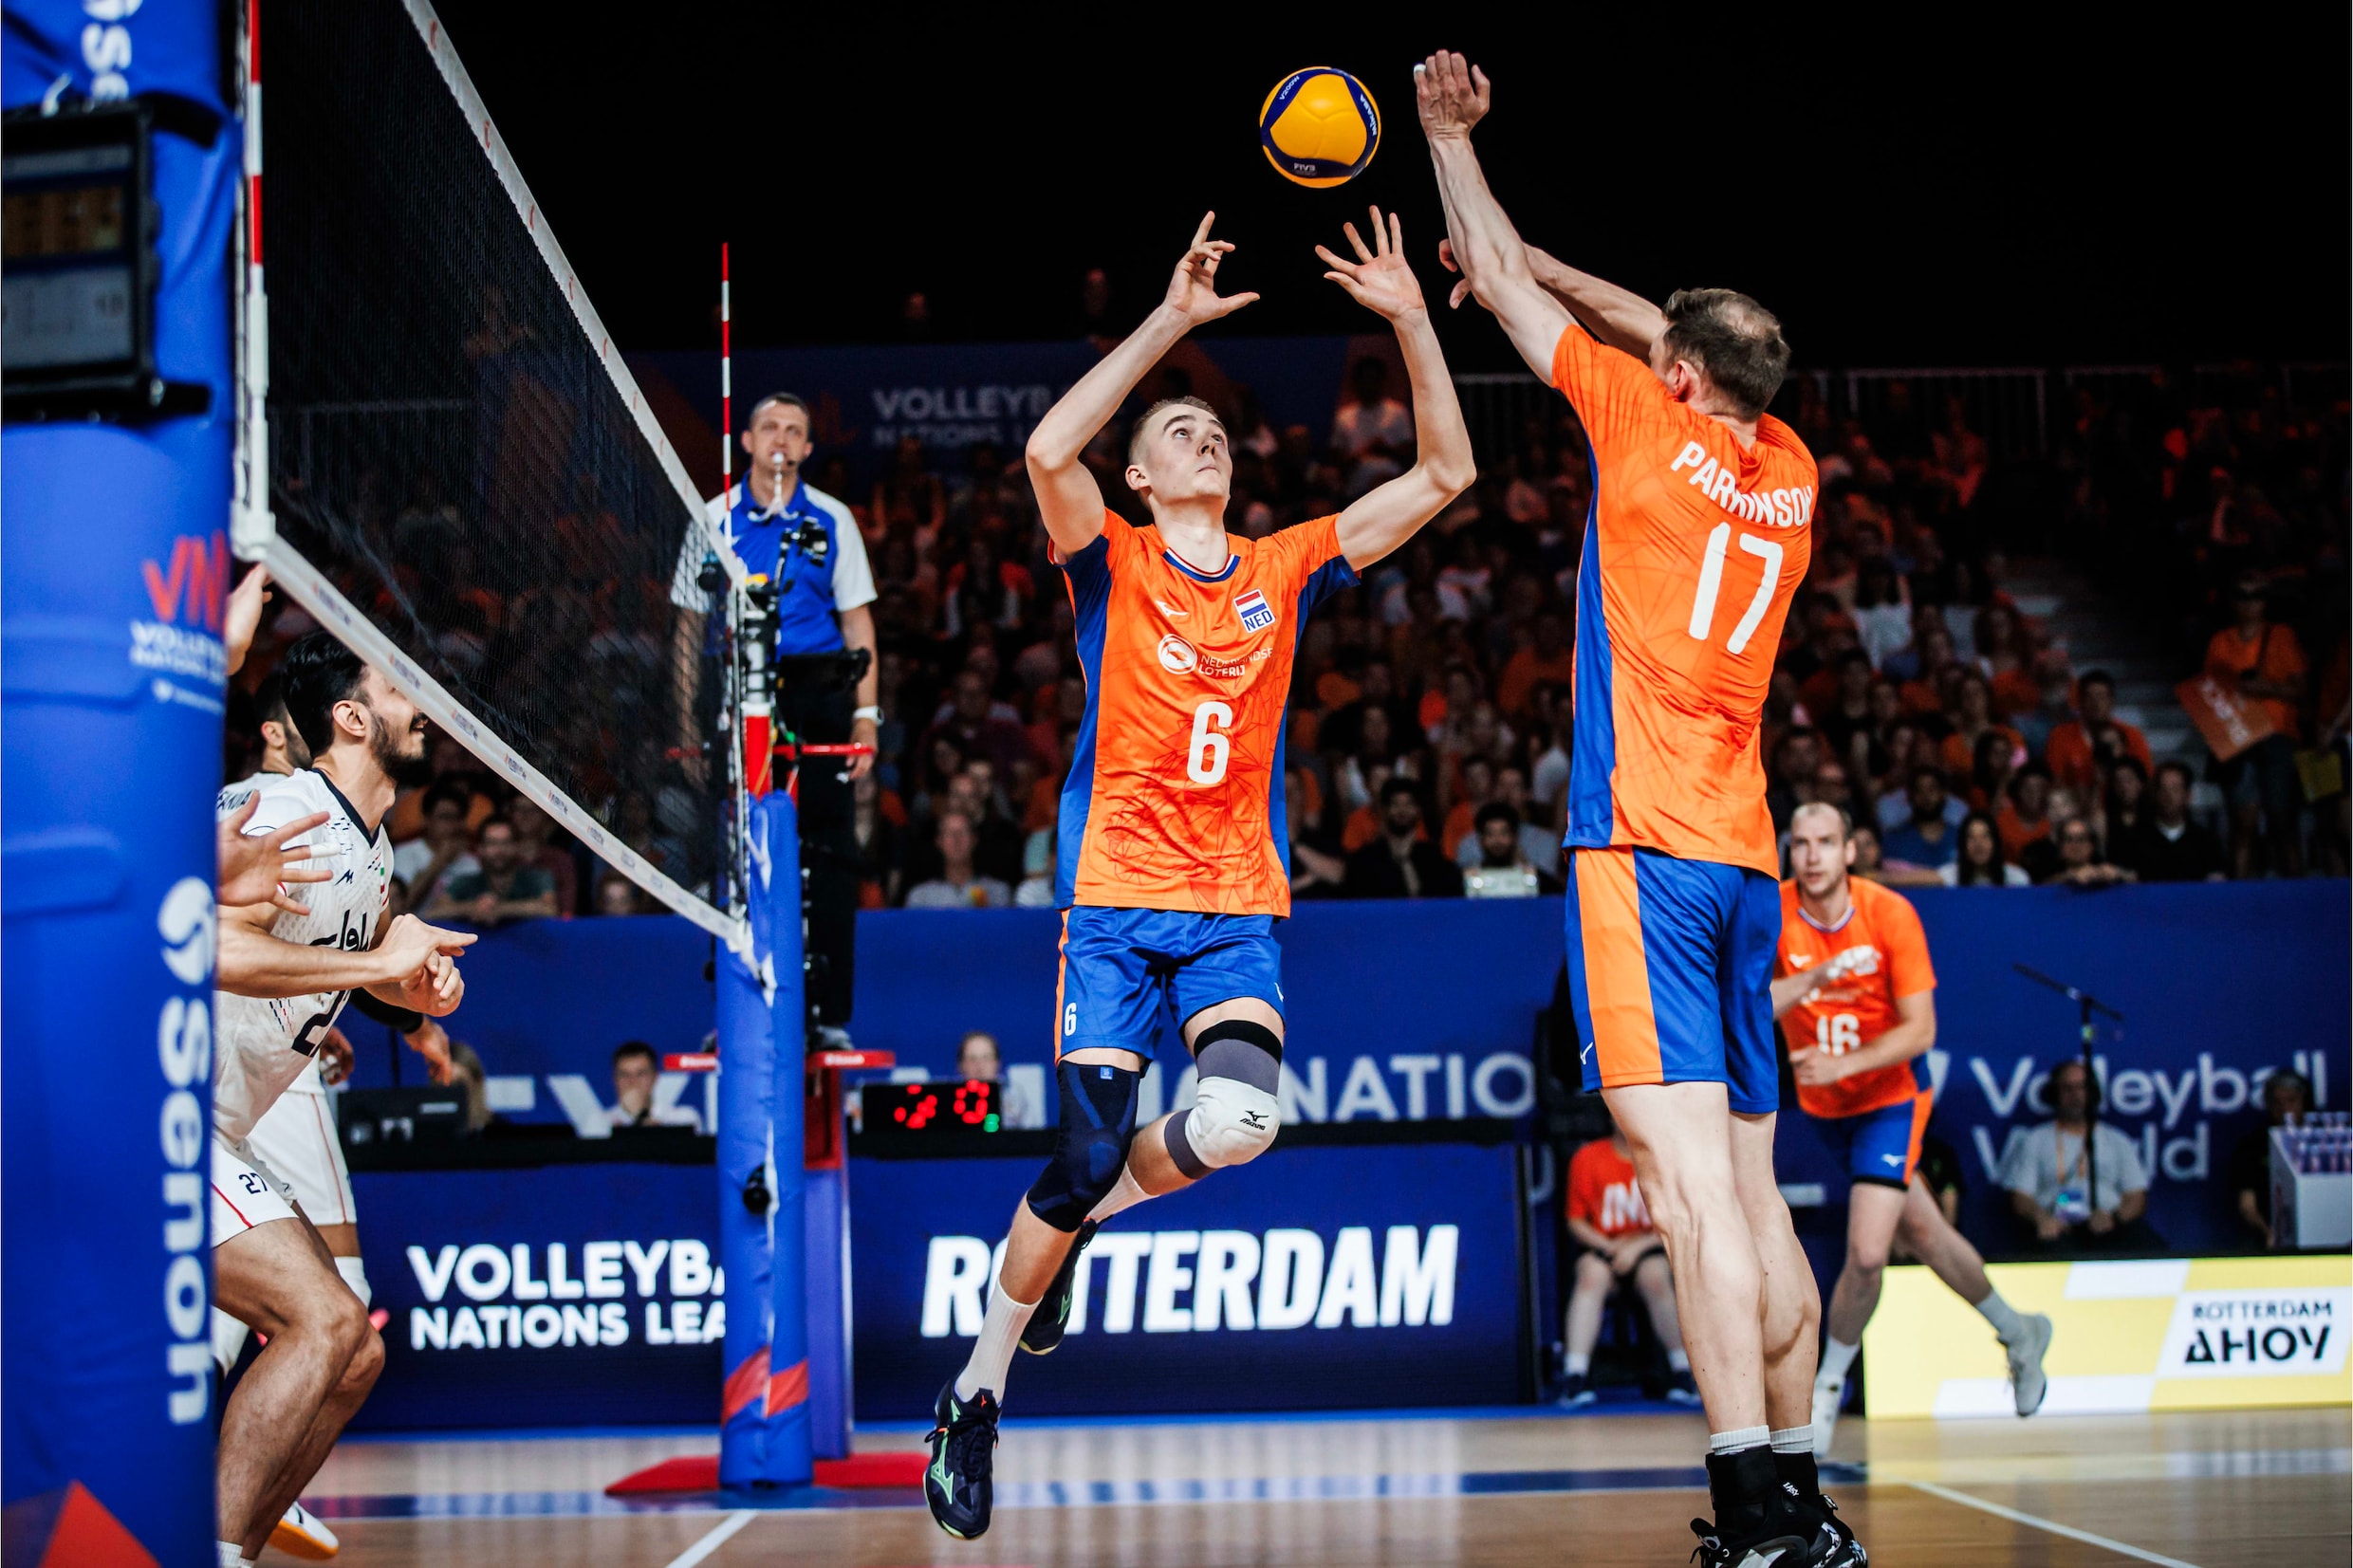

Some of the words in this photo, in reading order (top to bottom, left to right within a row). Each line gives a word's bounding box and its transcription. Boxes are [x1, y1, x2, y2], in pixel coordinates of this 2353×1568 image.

[1670, 440, 1813, 527] PARKINSON
[141, 528, 229, 632] VN
[1688, 522, 1784, 655] 17
[1244, 610, 1273, 632] NED
[1197, 664, 1246, 677] LOTERIJ
[1200, 647, 1273, 669] NEDRNDSE
[1186, 700, 1233, 785] 6
[1064, 1002, 1078, 1037] 6
[1816, 1012, 1861, 1057] 16
[1969, 1050, 2327, 1131] Voleybll
[1972, 1120, 2209, 1182] Wld
[239, 1173, 269, 1195] 27
[158, 995, 214, 1426] senoh
[920, 1224, 1459, 1337] RTTERDAM
[410, 1303, 629, 1351] NATIONS
[2193, 1301, 2332, 1319] ROTTERDAM
[2185, 1324, 2331, 1363] AHOY
